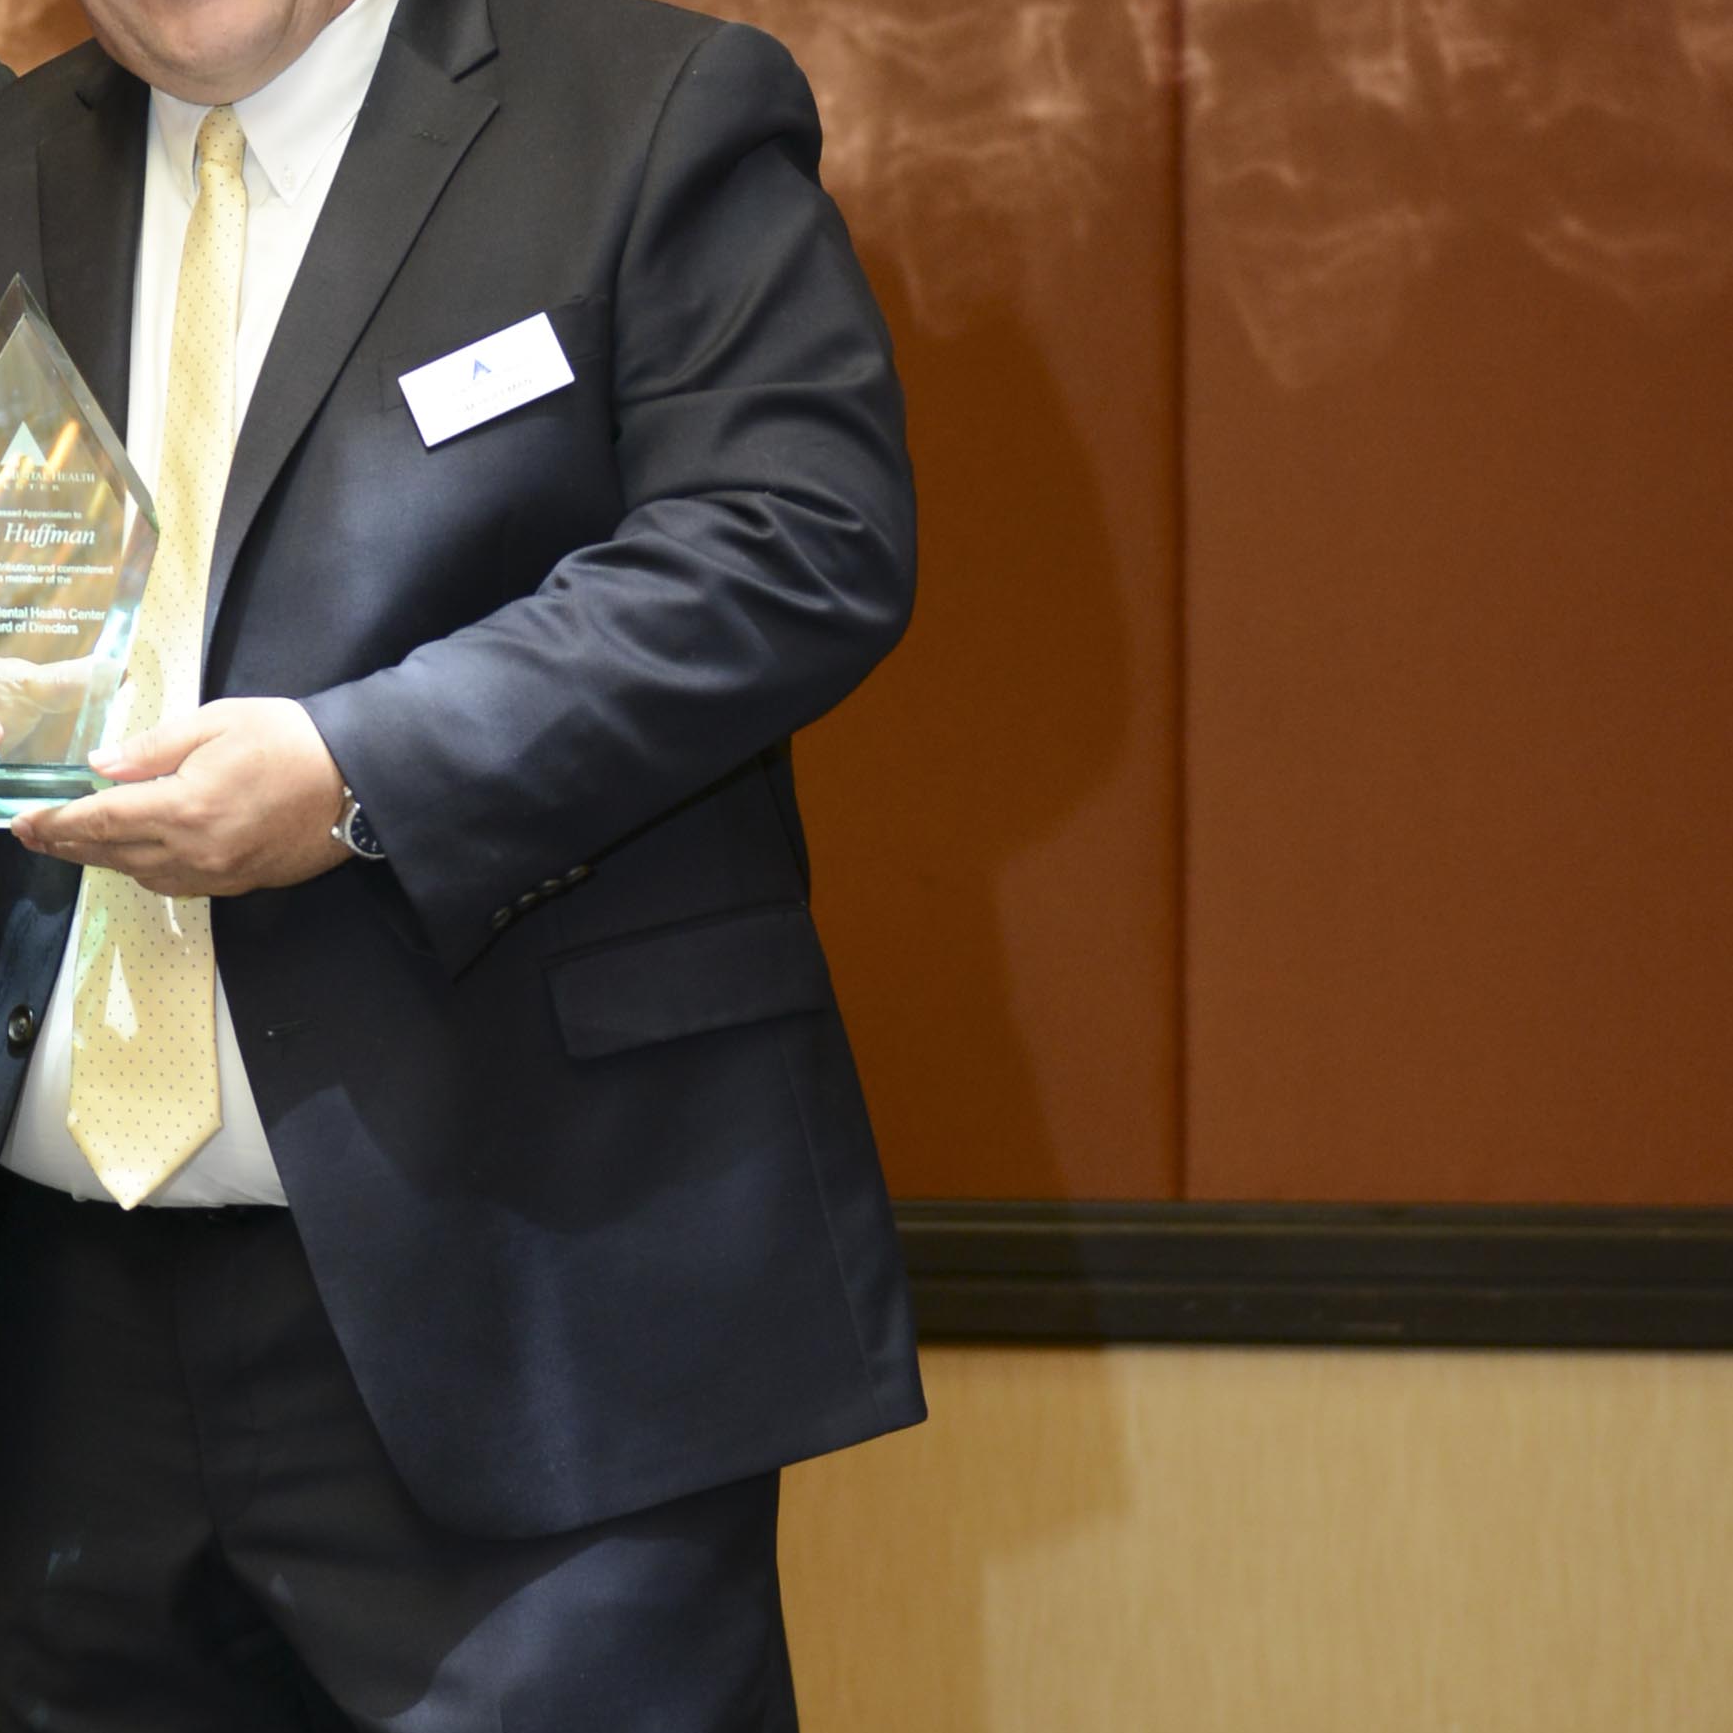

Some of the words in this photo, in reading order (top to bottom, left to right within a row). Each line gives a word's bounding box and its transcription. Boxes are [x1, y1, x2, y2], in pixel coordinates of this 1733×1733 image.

[23, 509, 73, 520] Appreciation
[4, 522, 96, 548] Huffman
[37, 563, 56, 574] and
[57, 563, 115, 575] commitment
[5, 573, 44, 584] member
[45, 574, 56, 584] of
[56, 575, 72, 585] the
[30, 606, 66, 619] Health
[68, 608, 107, 621] Center
[14, 620, 27, 634] of
[29, 621, 79, 635] Directors
